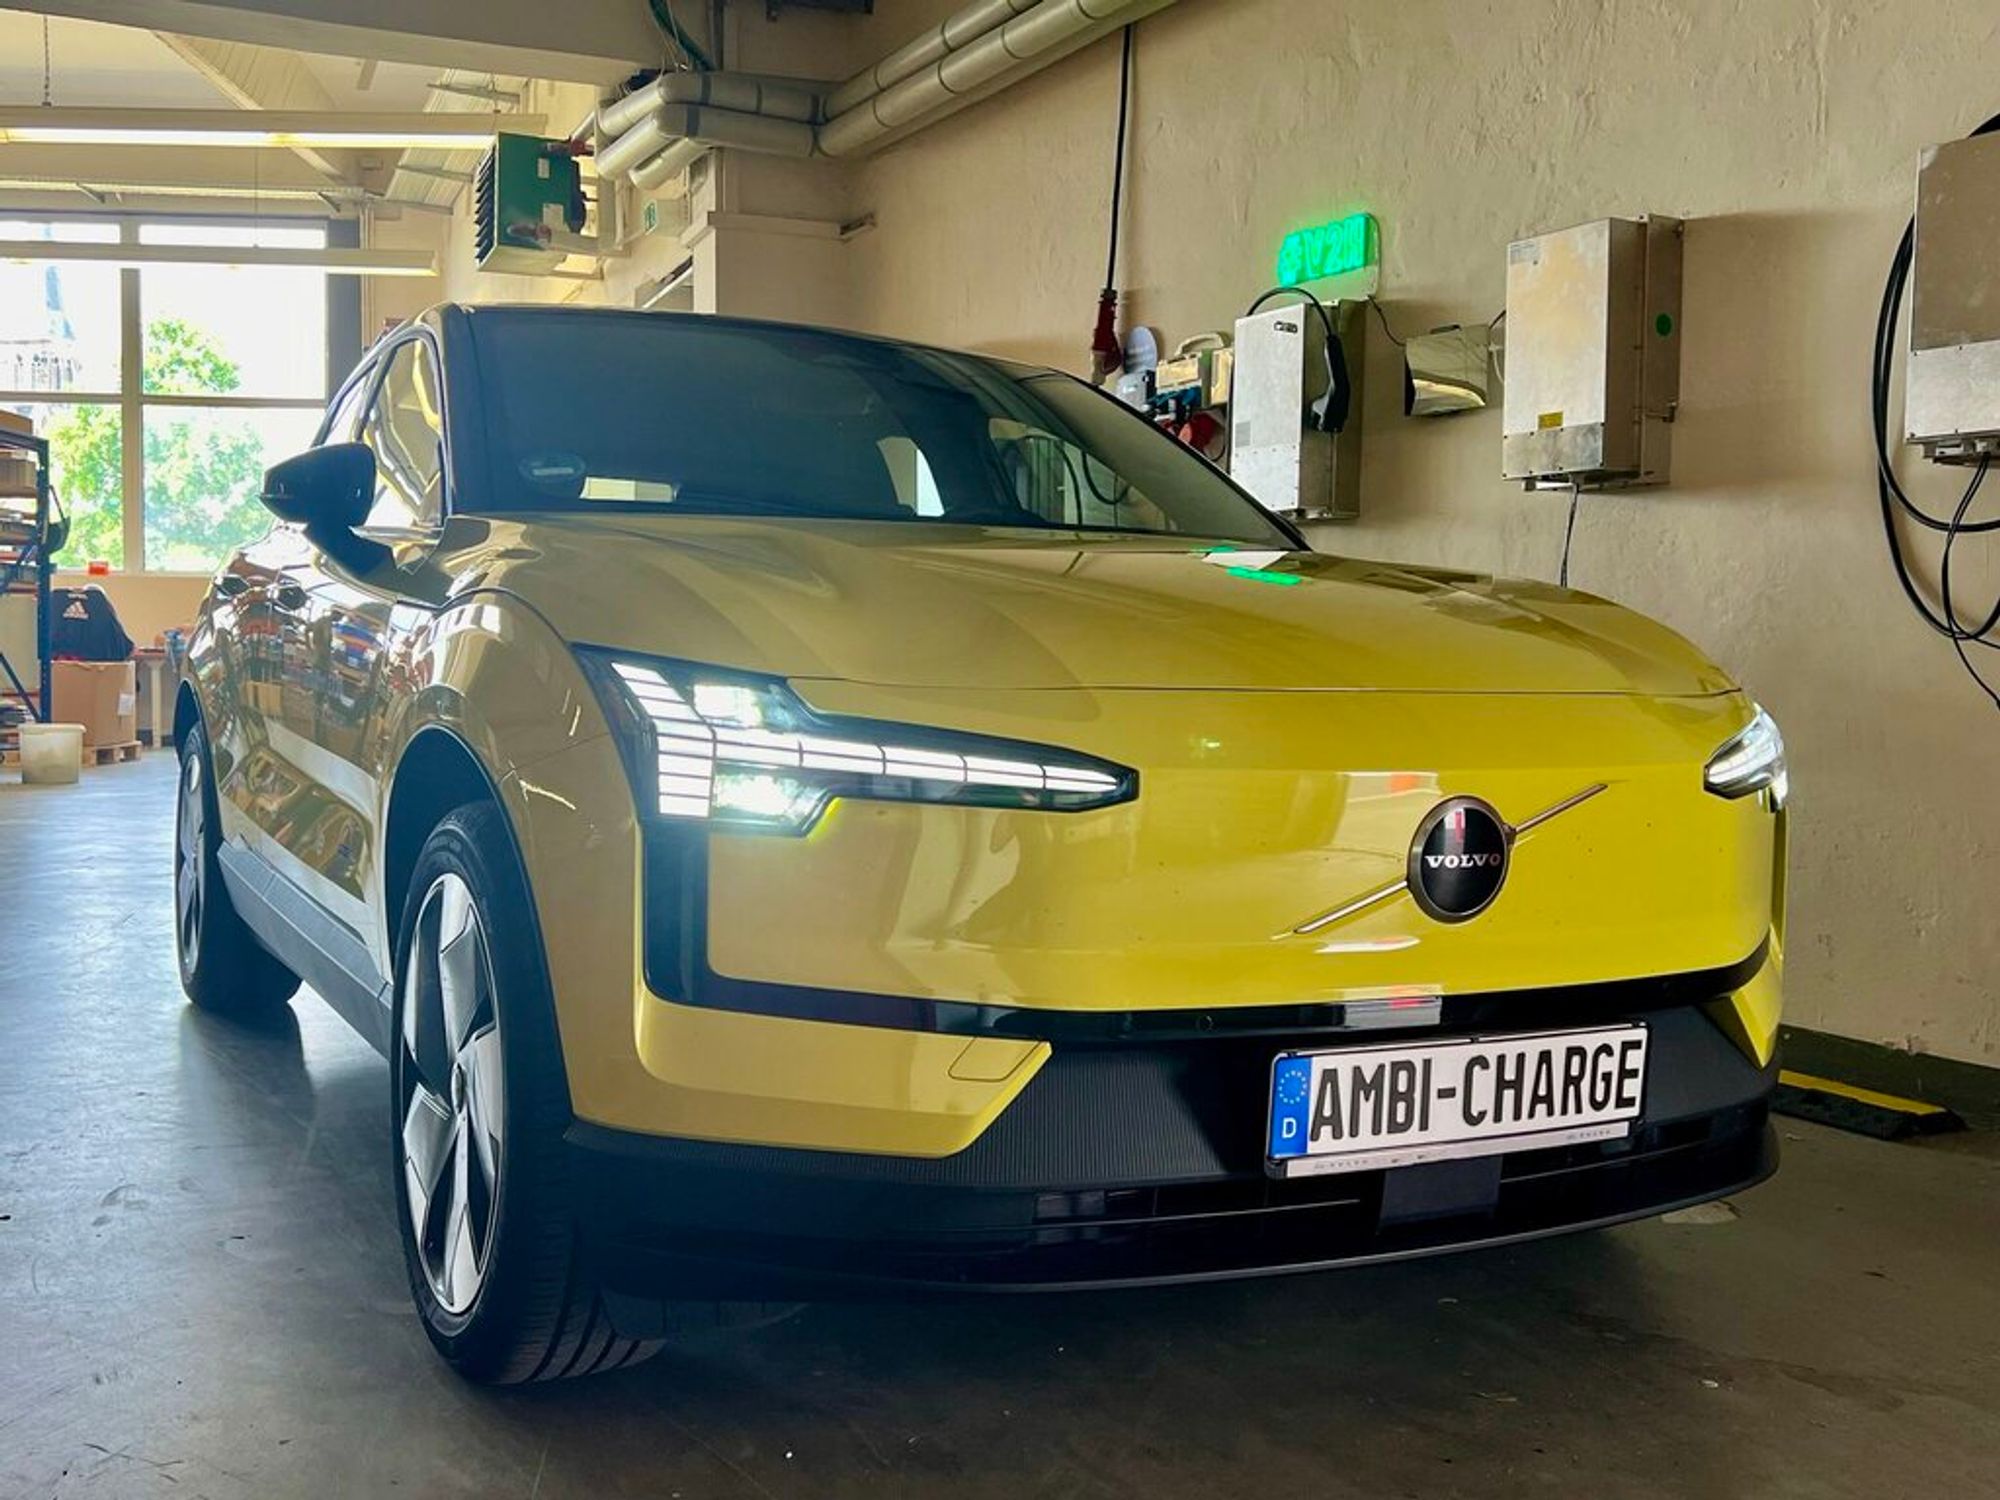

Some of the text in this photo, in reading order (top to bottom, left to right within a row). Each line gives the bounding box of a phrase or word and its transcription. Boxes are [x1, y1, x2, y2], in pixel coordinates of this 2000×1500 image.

[1425, 853, 1501, 869] VOLVO
[1282, 1039, 1643, 1142] D AMBI-CHARGE
